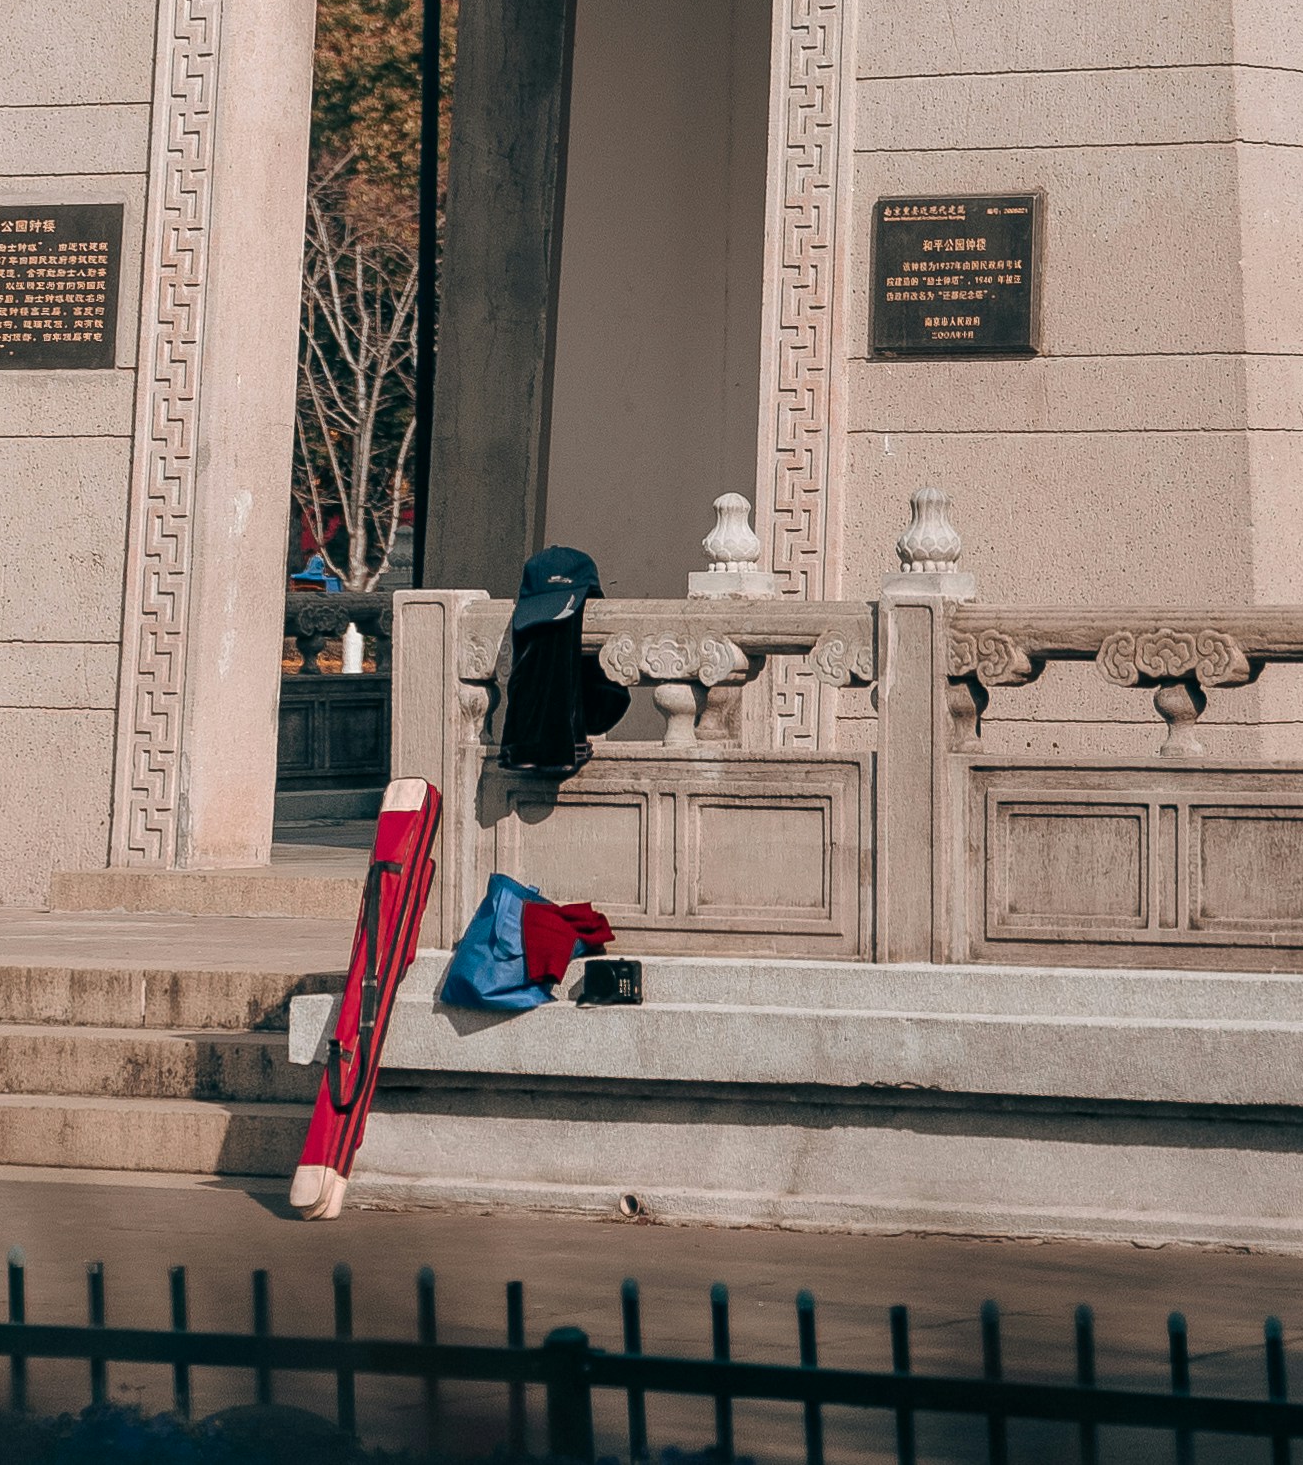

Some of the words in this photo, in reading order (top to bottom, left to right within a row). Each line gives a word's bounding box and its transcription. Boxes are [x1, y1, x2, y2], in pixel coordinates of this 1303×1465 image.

[922, 238, 987, 252] 和平公园钟楼
[924, 316, 981, 327] 南京市人民政府
